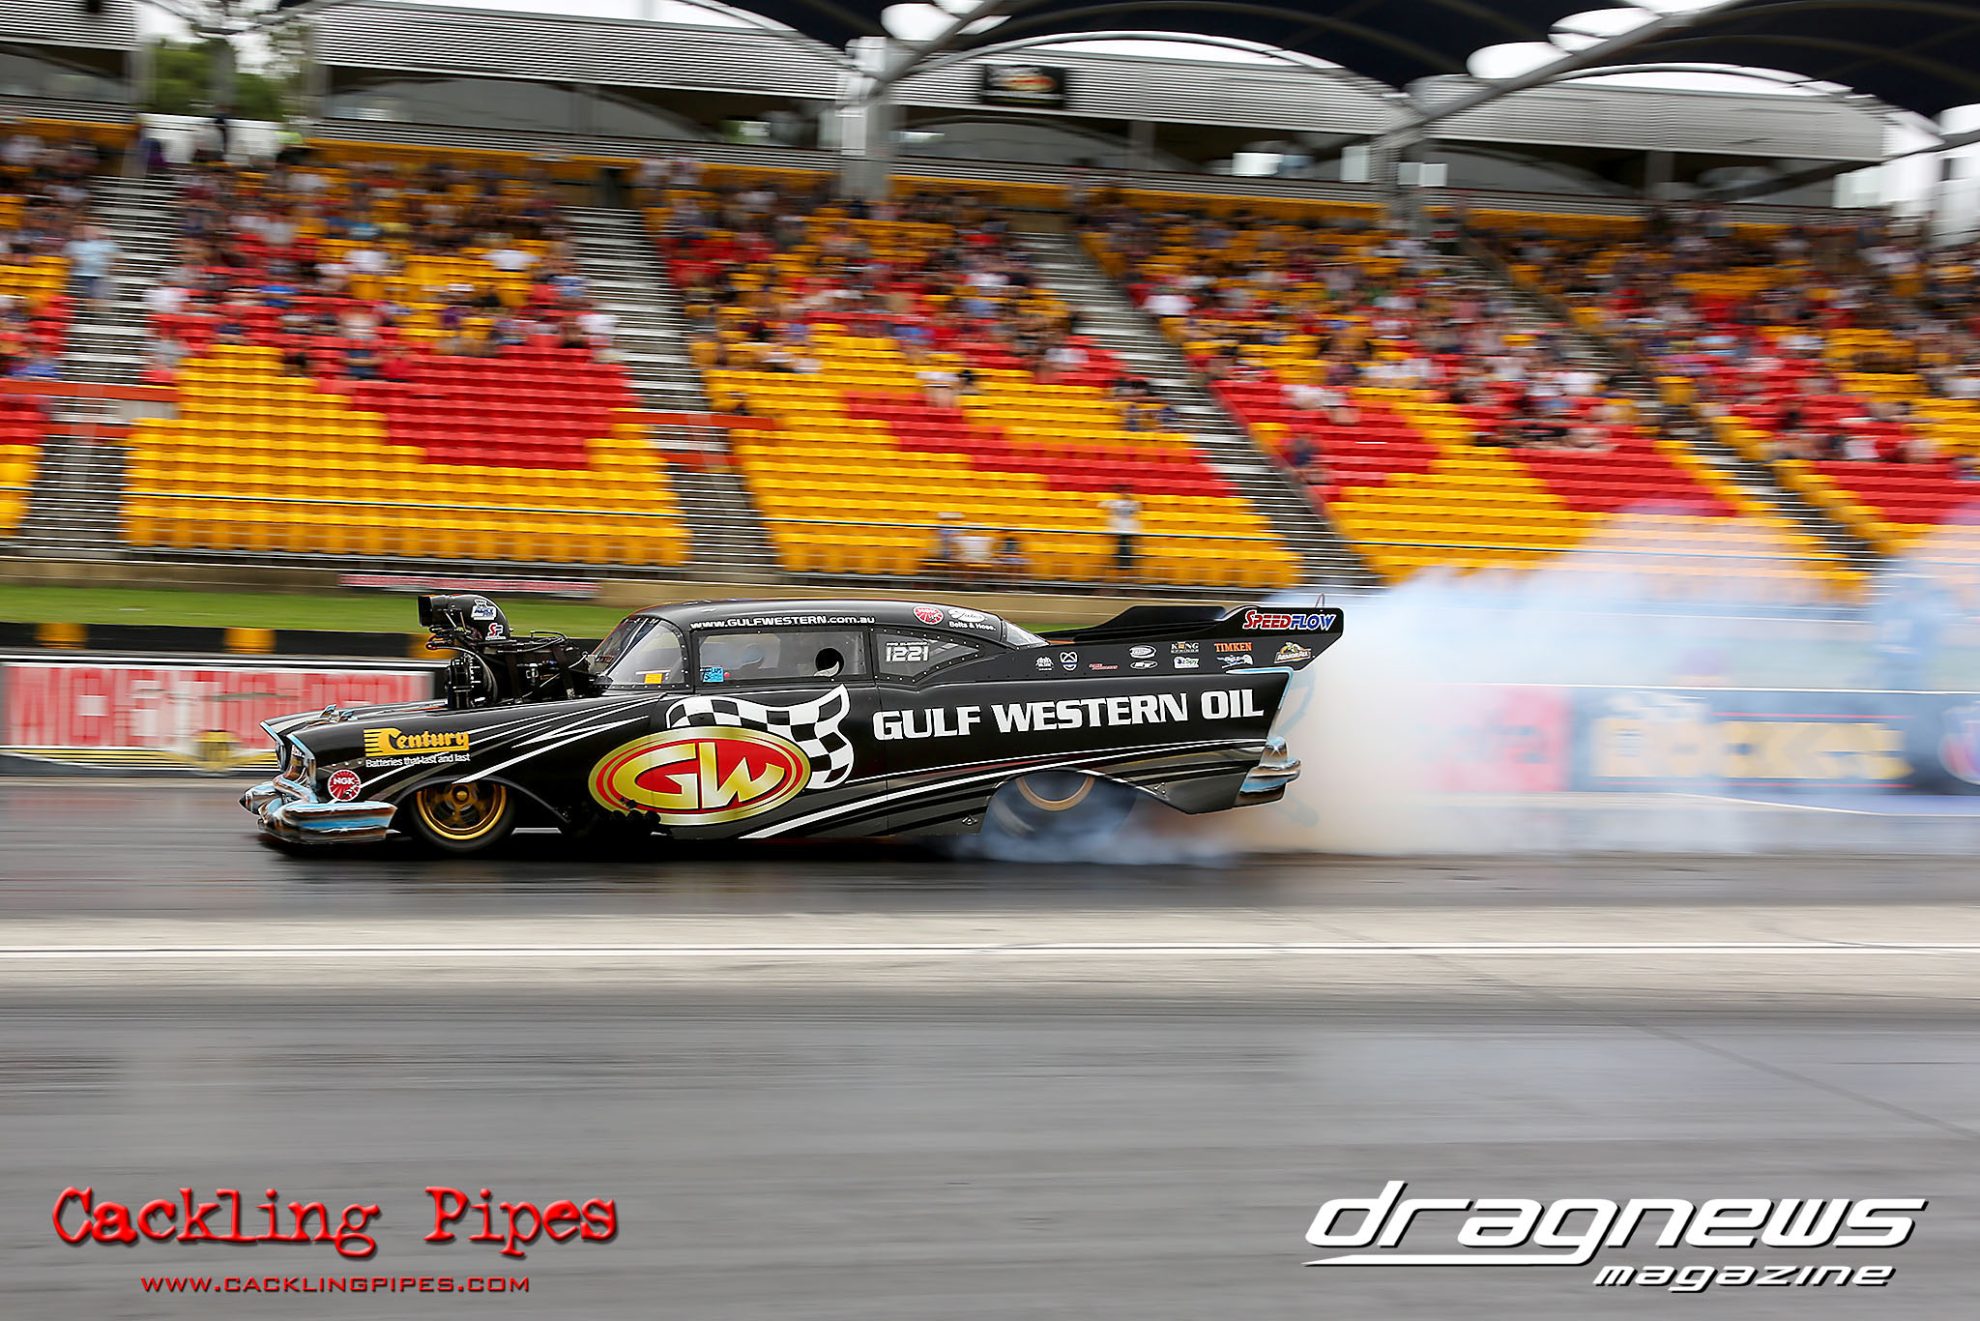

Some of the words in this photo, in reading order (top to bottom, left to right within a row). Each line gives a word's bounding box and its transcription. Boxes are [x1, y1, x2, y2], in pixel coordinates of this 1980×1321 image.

[690, 615, 875, 629] www.GULFWESTERN.com.au
[1242, 609, 1336, 631] SPEEDFLOW
[886, 646, 929, 662] 1221
[1214, 642, 1252, 653] TIMKEN
[873, 705, 981, 741] GULF
[991, 692, 1189, 733] WESTERN
[1200, 688, 1264, 720] OIL
[363, 727, 470, 757] Century
[366, 757, 403, 768] Batteries
[438, 754, 453, 763] and
[455, 753, 470, 762] last
[333, 776, 356, 785] NGK
[612, 742, 785, 809] GW
